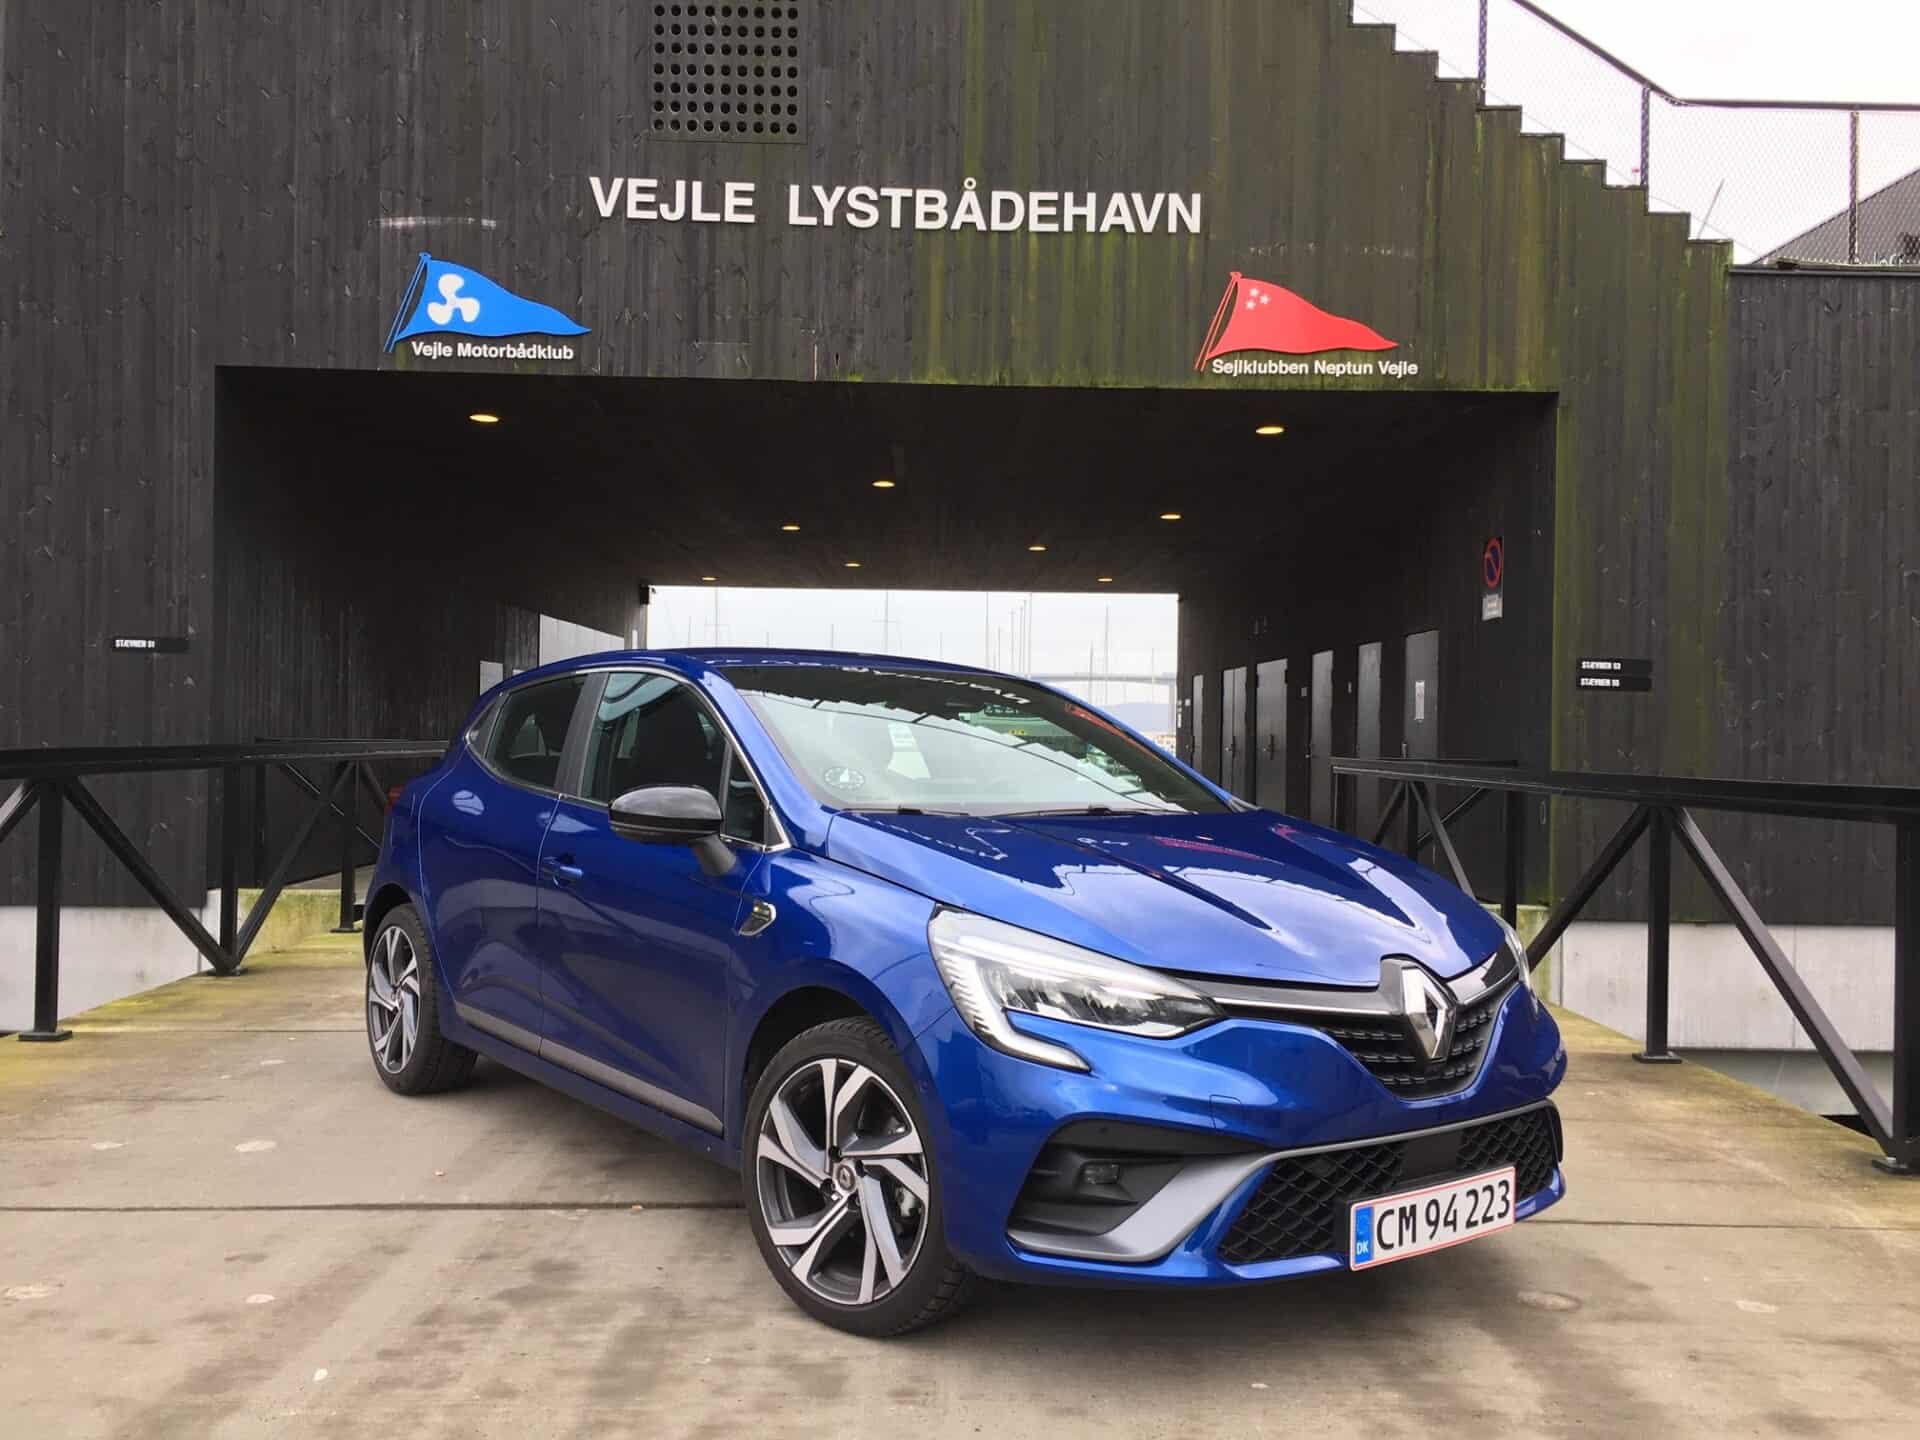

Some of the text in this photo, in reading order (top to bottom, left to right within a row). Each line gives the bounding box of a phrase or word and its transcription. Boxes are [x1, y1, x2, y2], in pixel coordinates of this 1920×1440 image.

[589, 176, 1201, 233] VEJLE LYSTBÅDEHAVN
[411, 341, 574, 360] Vejle Motorbådklub
[1212, 359, 1419, 378] Sejlklubben Neptun Vejle
[1376, 1179, 1511, 1251] CM 94 223
[1356, 1241, 1369, 1255] DK
